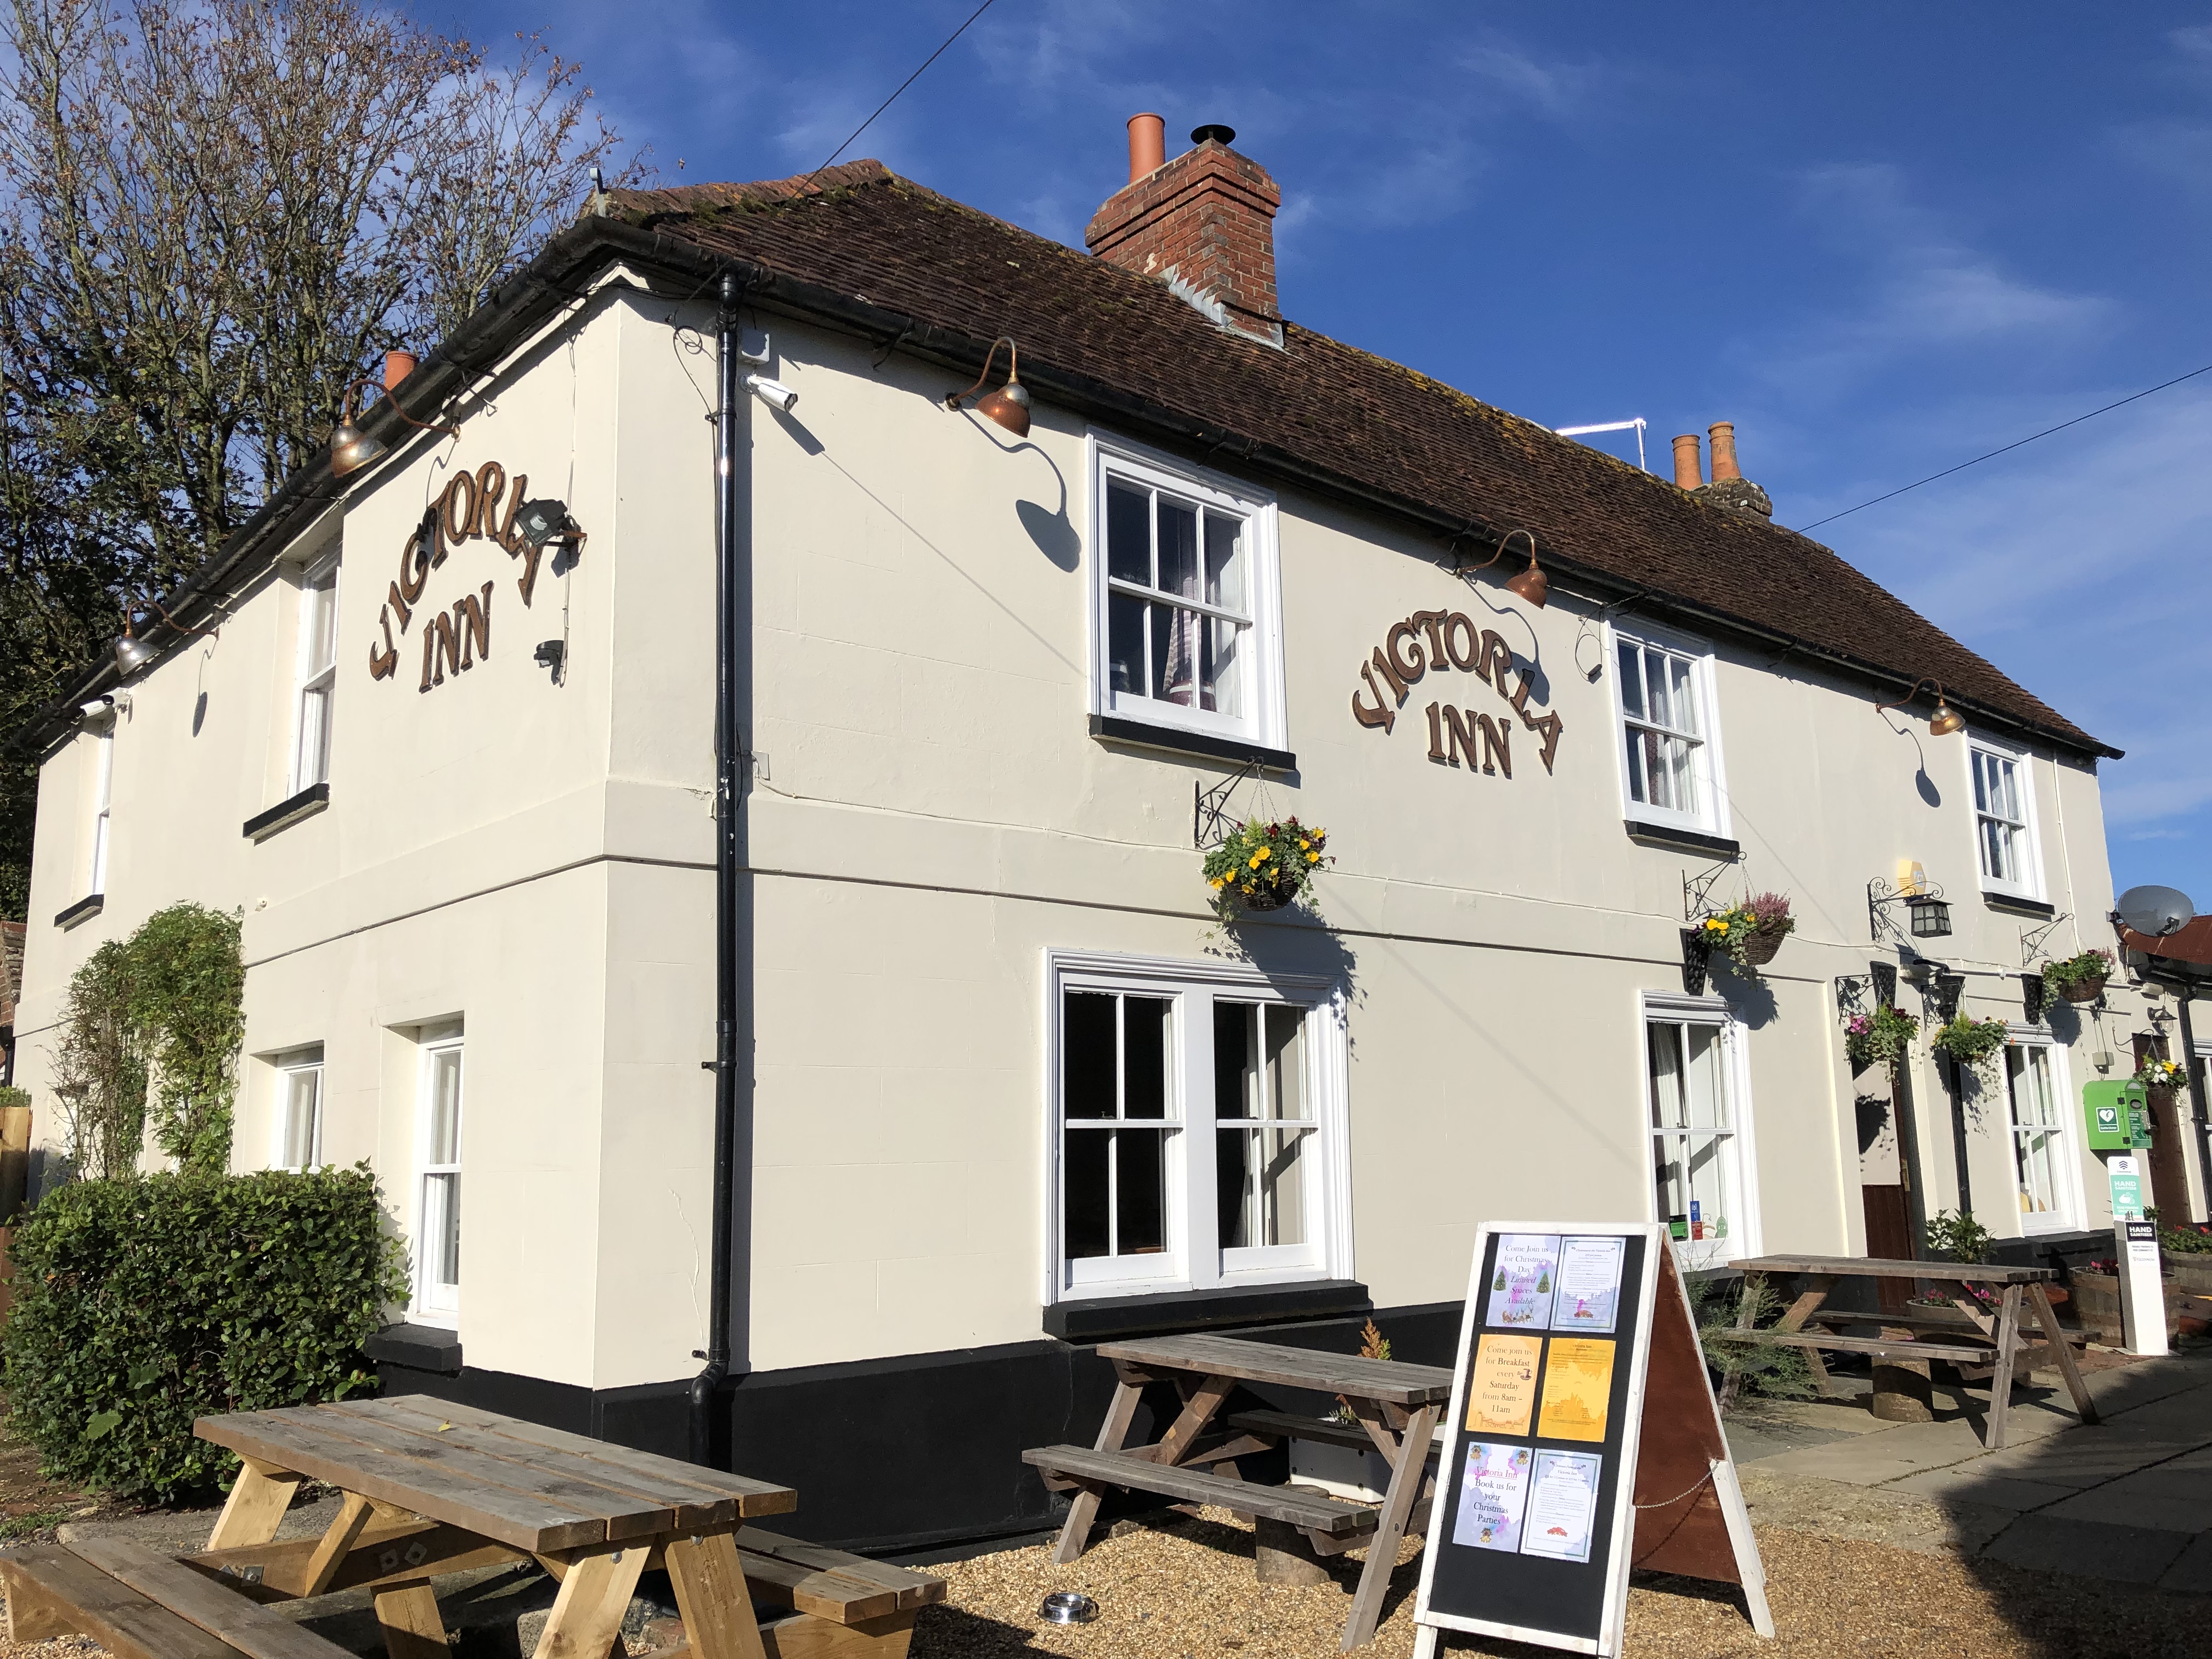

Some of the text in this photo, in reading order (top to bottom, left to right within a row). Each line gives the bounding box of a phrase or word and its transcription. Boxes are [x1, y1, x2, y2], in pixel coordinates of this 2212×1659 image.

[419, 580, 495, 695] INN
[1352, 609, 1564, 777] VICTORIA
[1425, 702, 1513, 780] INN
[1510, 1286, 1532, 1295] Spaces
[1487, 1345, 1508, 1353] Come
[1509, 1346, 1522, 1355] join
[1498, 1357, 1530, 1367] Breakfast
[1489, 1381, 1520, 1391] Saturday
[1482, 1392, 1499, 1401] from
[1501, 1393, 1516, 1402] 8am
[1492, 1404, 1510, 1413] 11am
[1476, 1466, 1517, 1479] Victoria Inn
[1475, 1479, 1494, 1488] Book
[1506, 1482, 1517, 1491] for
[1484, 1493, 1501, 1501] your
[1474, 1502, 1508, 1514] Christmas
[1477, 1514, 1501, 1525] Parties
